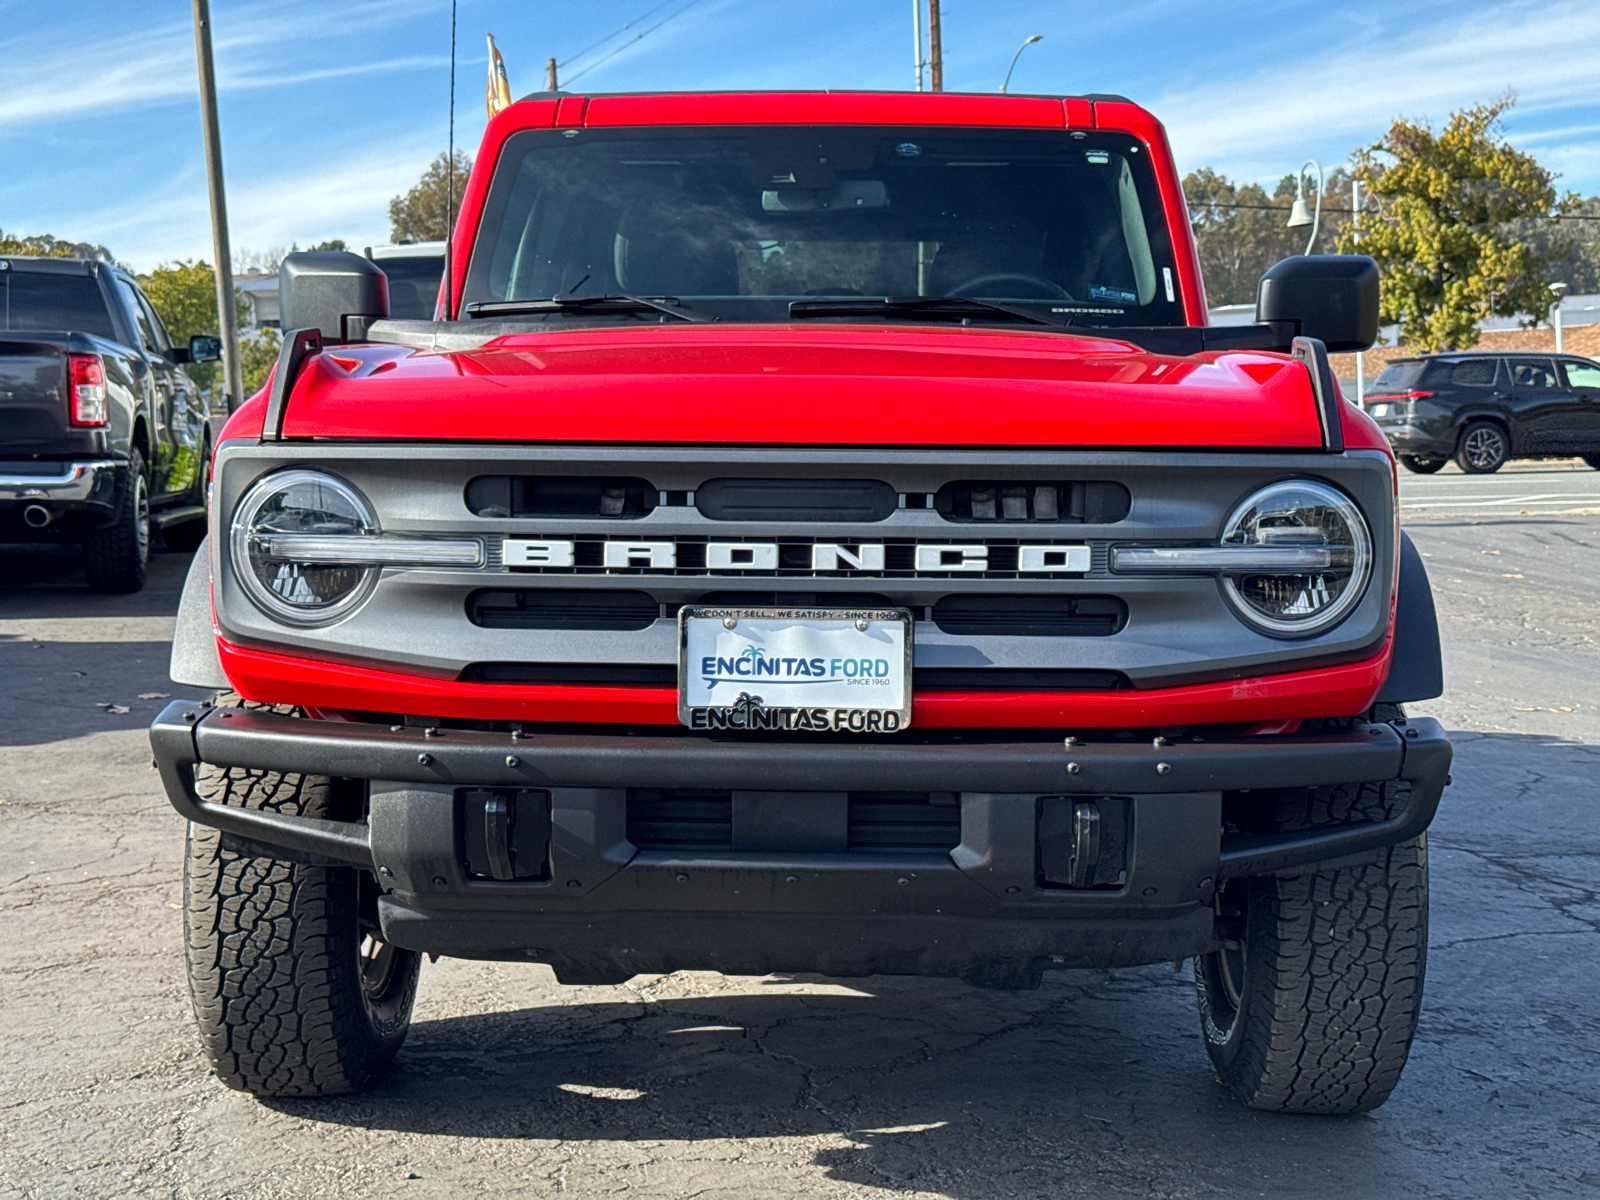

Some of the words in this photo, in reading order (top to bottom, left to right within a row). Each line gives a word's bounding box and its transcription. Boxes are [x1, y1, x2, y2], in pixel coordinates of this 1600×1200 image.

[502, 539, 1092, 573] BRONCO
[694, 609, 709, 617] WE
[778, 610, 792, 618] WE
[844, 611, 873, 619] SINCE
[876, 611, 899, 620] 1960
[702, 655, 826, 677] ENCINITAS
[830, 658, 889, 678] FORD
[846, 678, 871, 686] SINCE
[690, 707, 830, 730] ENCINITAS
[833, 709, 900, 732] FORD
